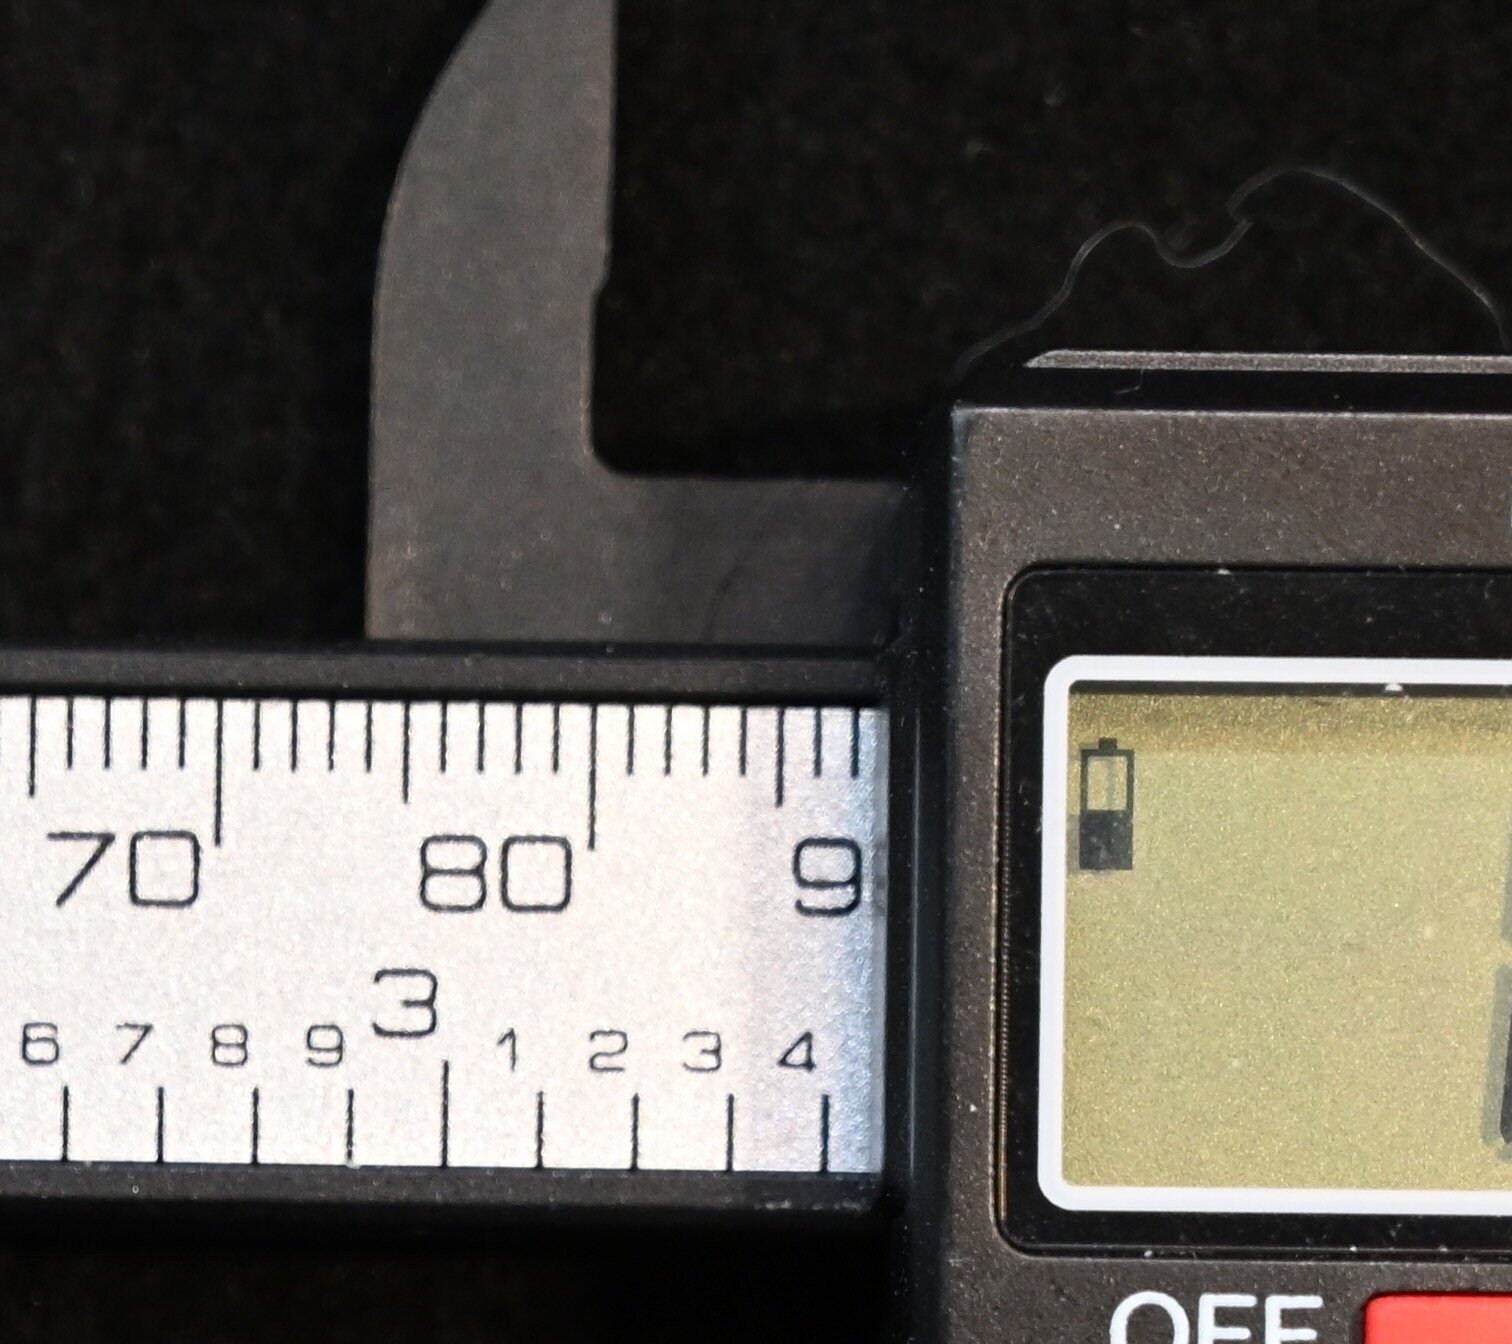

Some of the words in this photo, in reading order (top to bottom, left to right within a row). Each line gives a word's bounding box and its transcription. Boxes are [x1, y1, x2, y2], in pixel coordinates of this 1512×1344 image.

[46, 828, 203, 911] 70
[417, 832, 574, 915] 80
[371, 966, 439, 1040] 3
[19, 1021, 62, 1068] 6
[116, 1021, 154, 1066] 7
[209, 1022, 250, 1069] 8
[304, 1022, 346, 1069] 9
[496, 1028, 518, 1071] 1
[588, 1028, 629, 1074] 2
[682, 1029, 723, 1074] 3
[775, 1029, 818, 1074] 4
